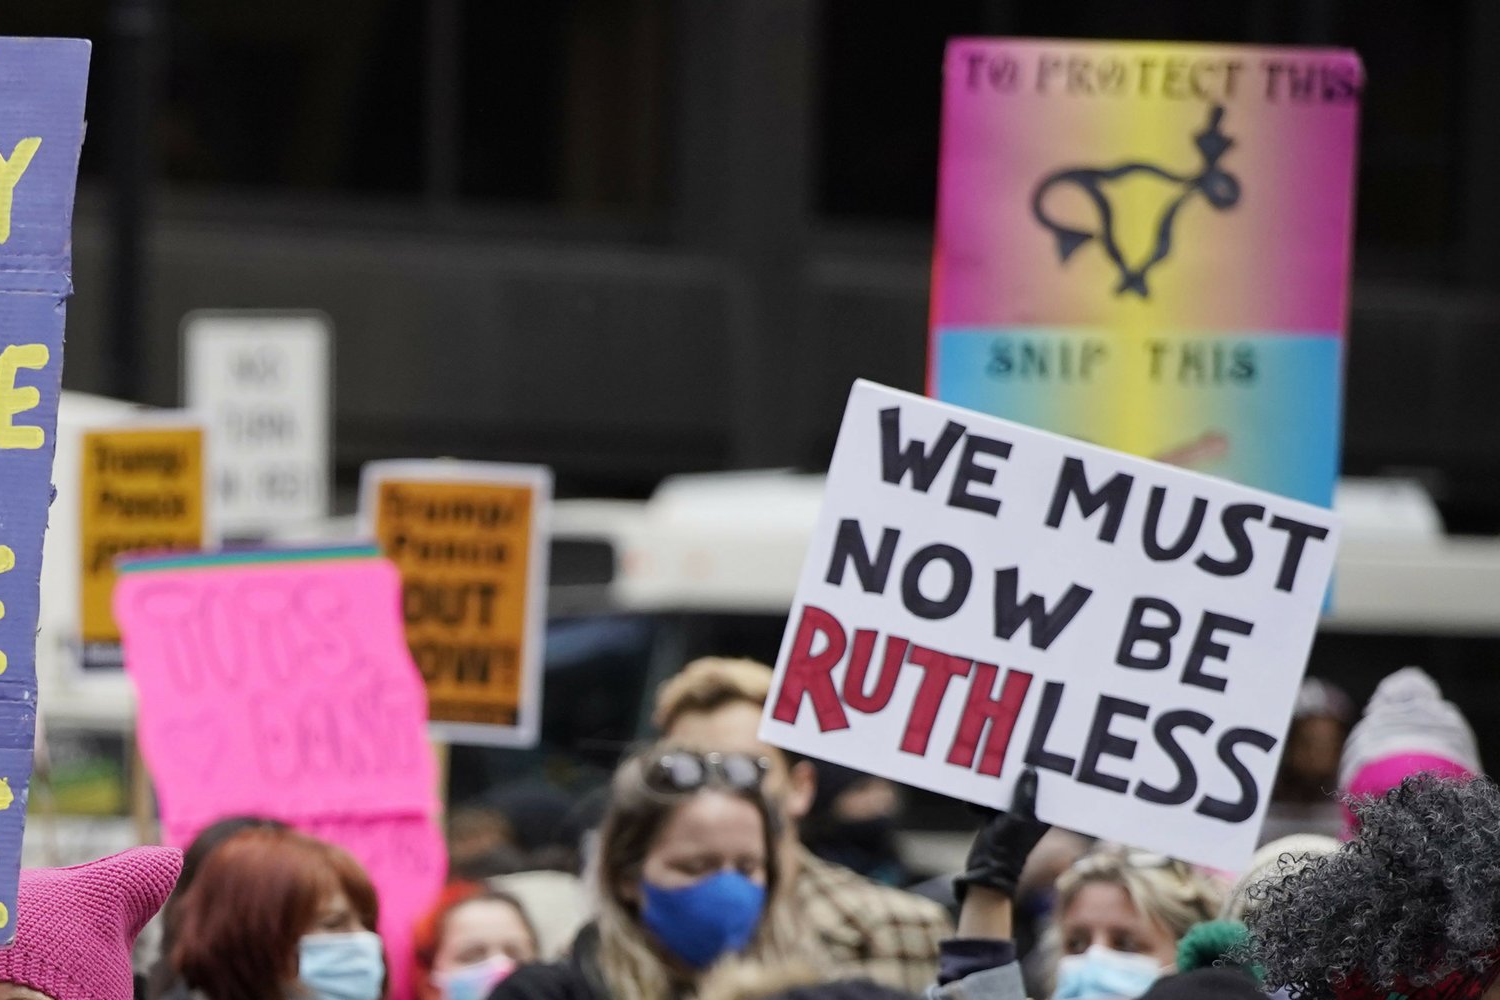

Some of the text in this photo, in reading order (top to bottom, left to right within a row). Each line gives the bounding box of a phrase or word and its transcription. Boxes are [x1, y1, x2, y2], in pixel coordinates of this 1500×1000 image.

[963, 50, 1357, 100] TO PROTECT THIS
[986, 338, 1258, 386] SNIP THIS
[879, 406, 1329, 593] WE MUST
[390, 531, 512, 565] Pence
[402, 580, 499, 629] OUT
[825, 519, 1254, 693] NOW BE
[414, 640, 518, 686] OW!
[772, 605, 1278, 825] RUTHLESS
